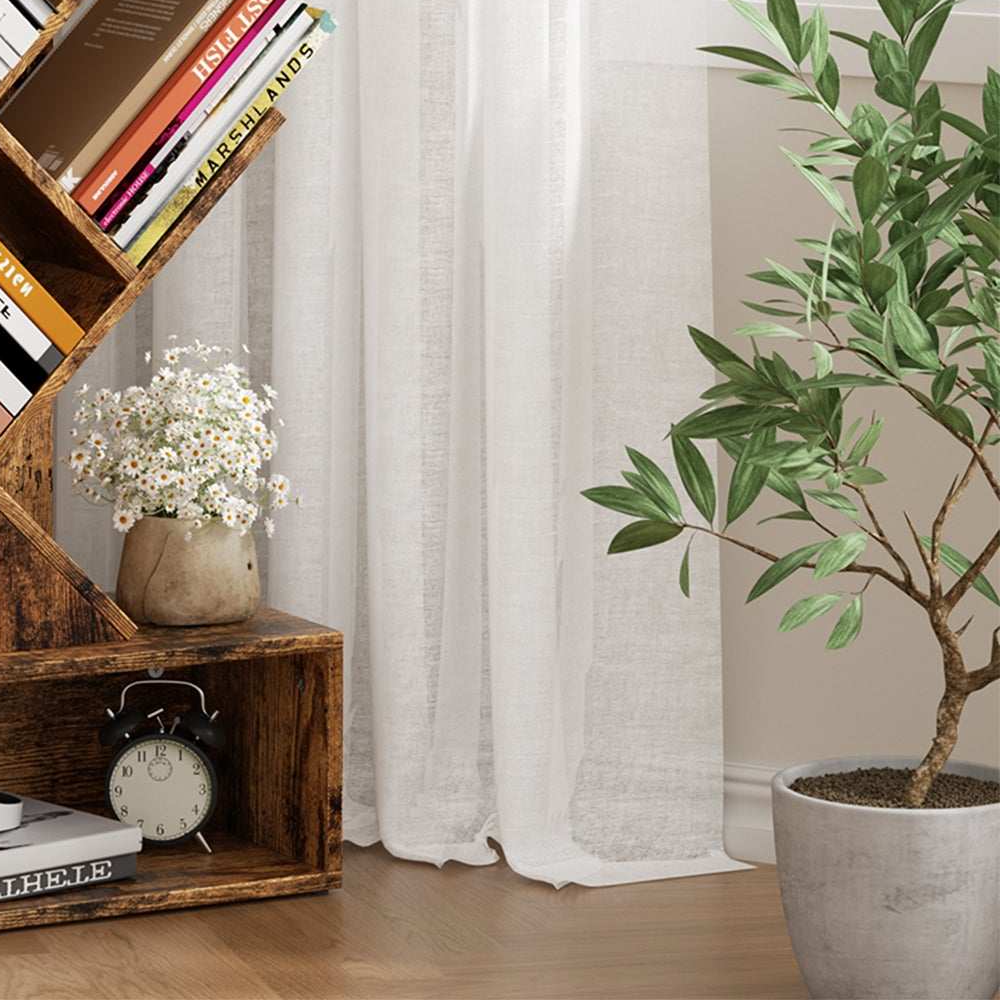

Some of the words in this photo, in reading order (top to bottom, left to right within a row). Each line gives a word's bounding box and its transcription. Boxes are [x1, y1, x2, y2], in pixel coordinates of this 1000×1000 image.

[188, 26, 241, 83] FISH
[191, 42, 315, 187] MARSHLANDS
[137, 751, 147, 763] 11
[155, 745, 167, 757] 12
[178, 750, 183, 761] 1
[122, 766, 133, 777] 10
[192, 763, 201, 775] 2
[114, 785, 123, 798] 9
[198, 784, 207, 796] 3
[121, 806, 129, 817] 8
[192, 804, 199, 815] 4
[156, 823, 165, 836] 6
[179, 818, 187, 830] 5
